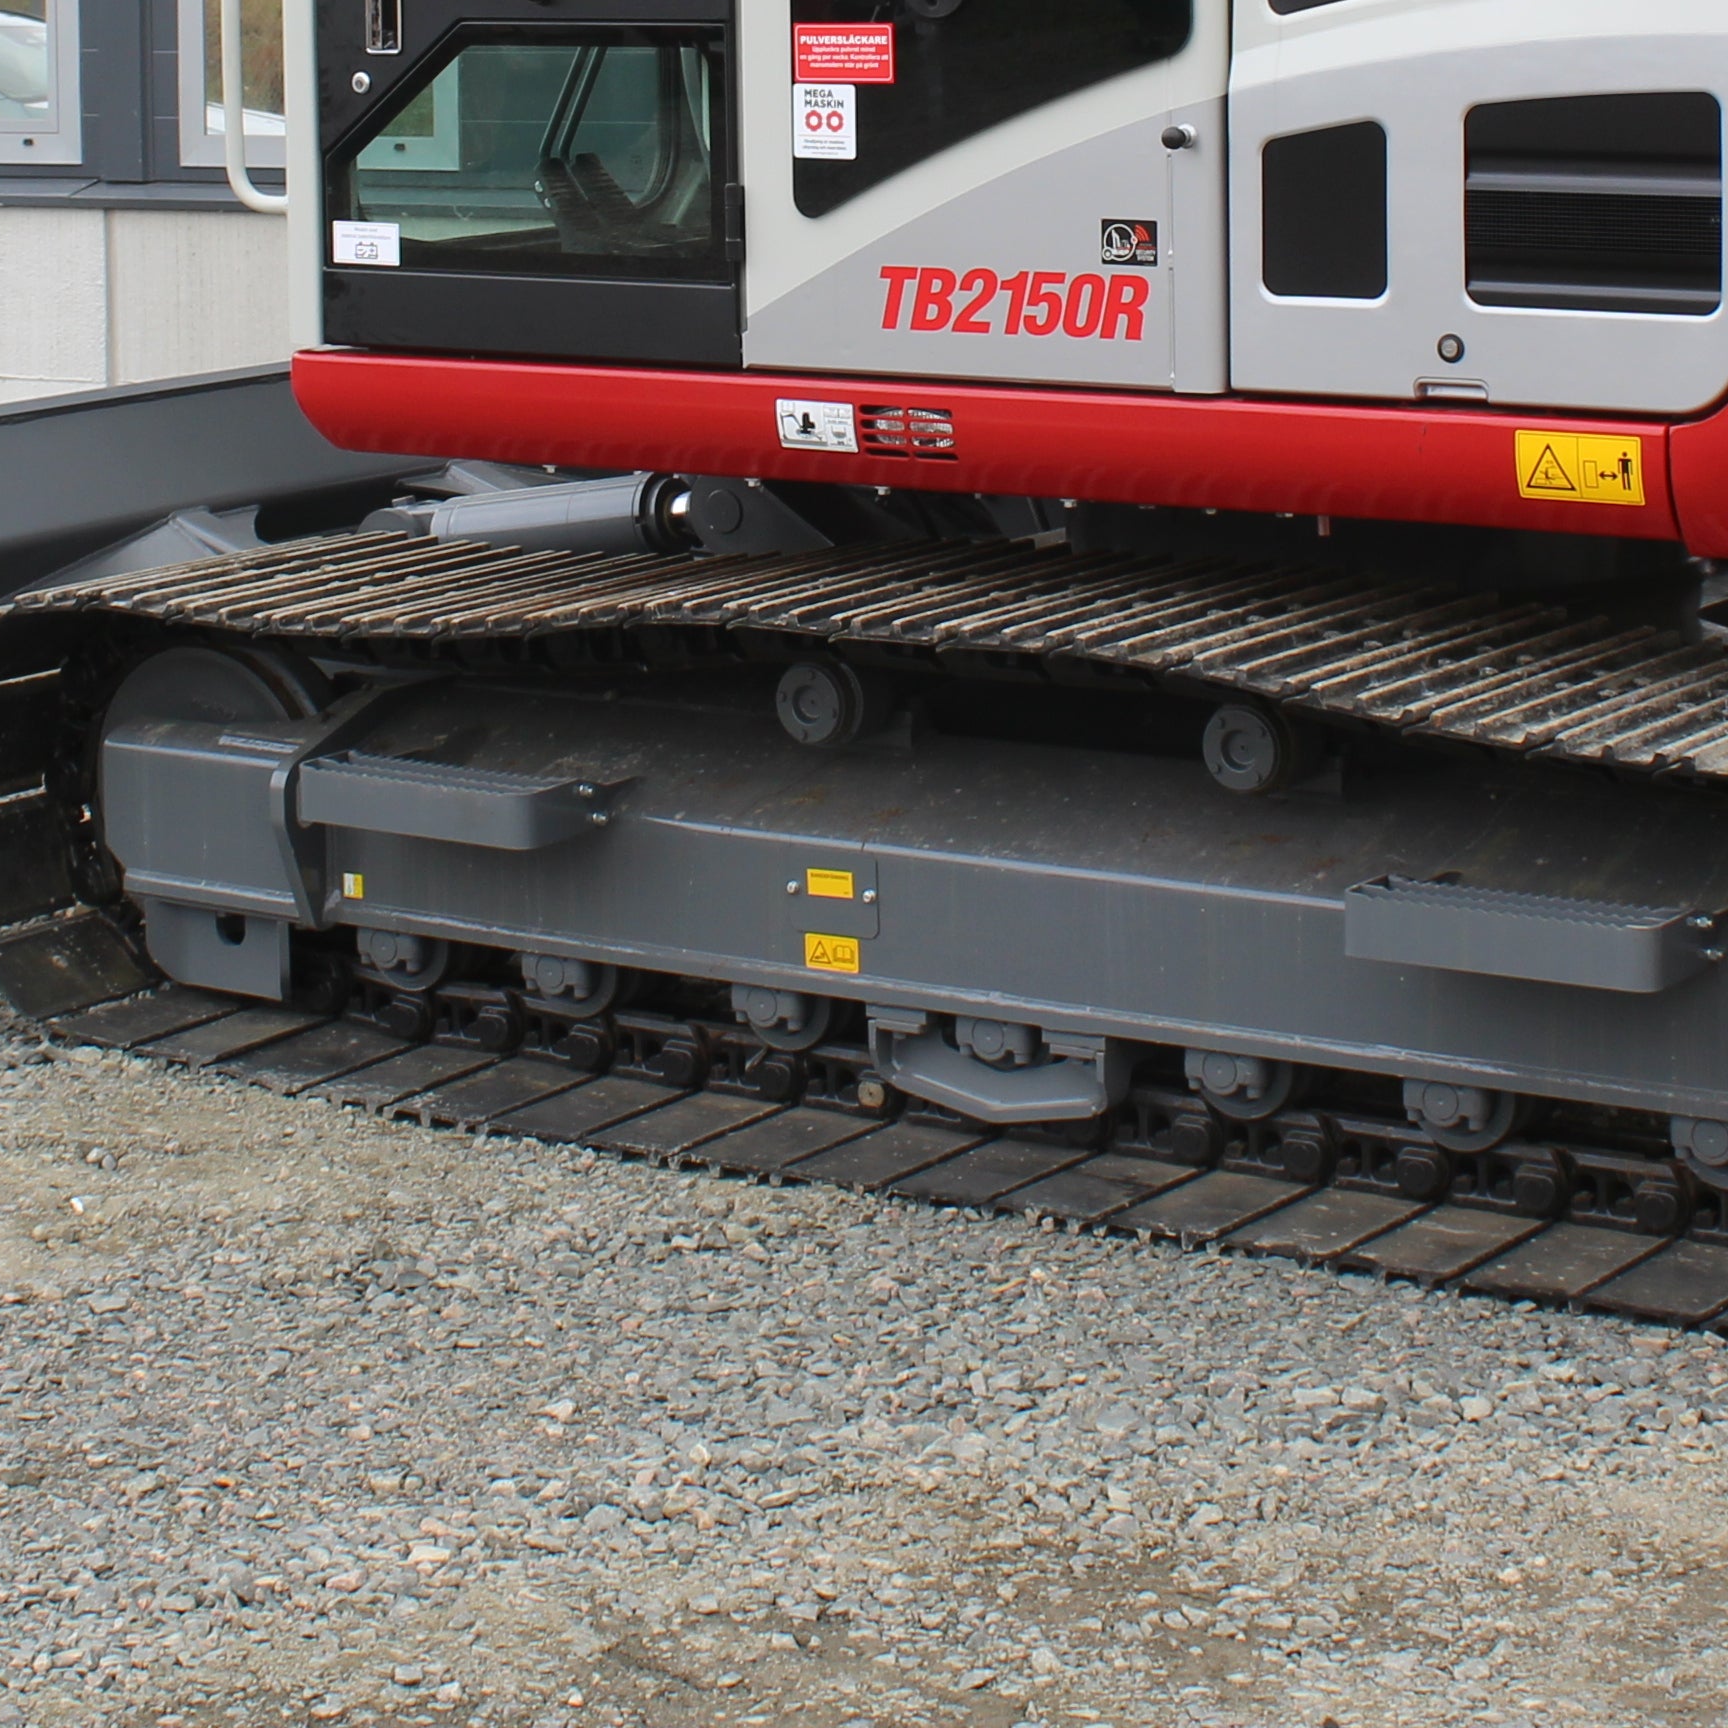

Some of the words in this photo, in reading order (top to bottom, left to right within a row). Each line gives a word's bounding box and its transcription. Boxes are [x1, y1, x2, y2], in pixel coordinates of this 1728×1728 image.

[800, 34, 888, 45] PULVERSLÄCKARE
[804, 89, 833, 98] MEGA
[804, 99, 844, 108] MASKIN
[878, 265, 1150, 341] TB2150R
